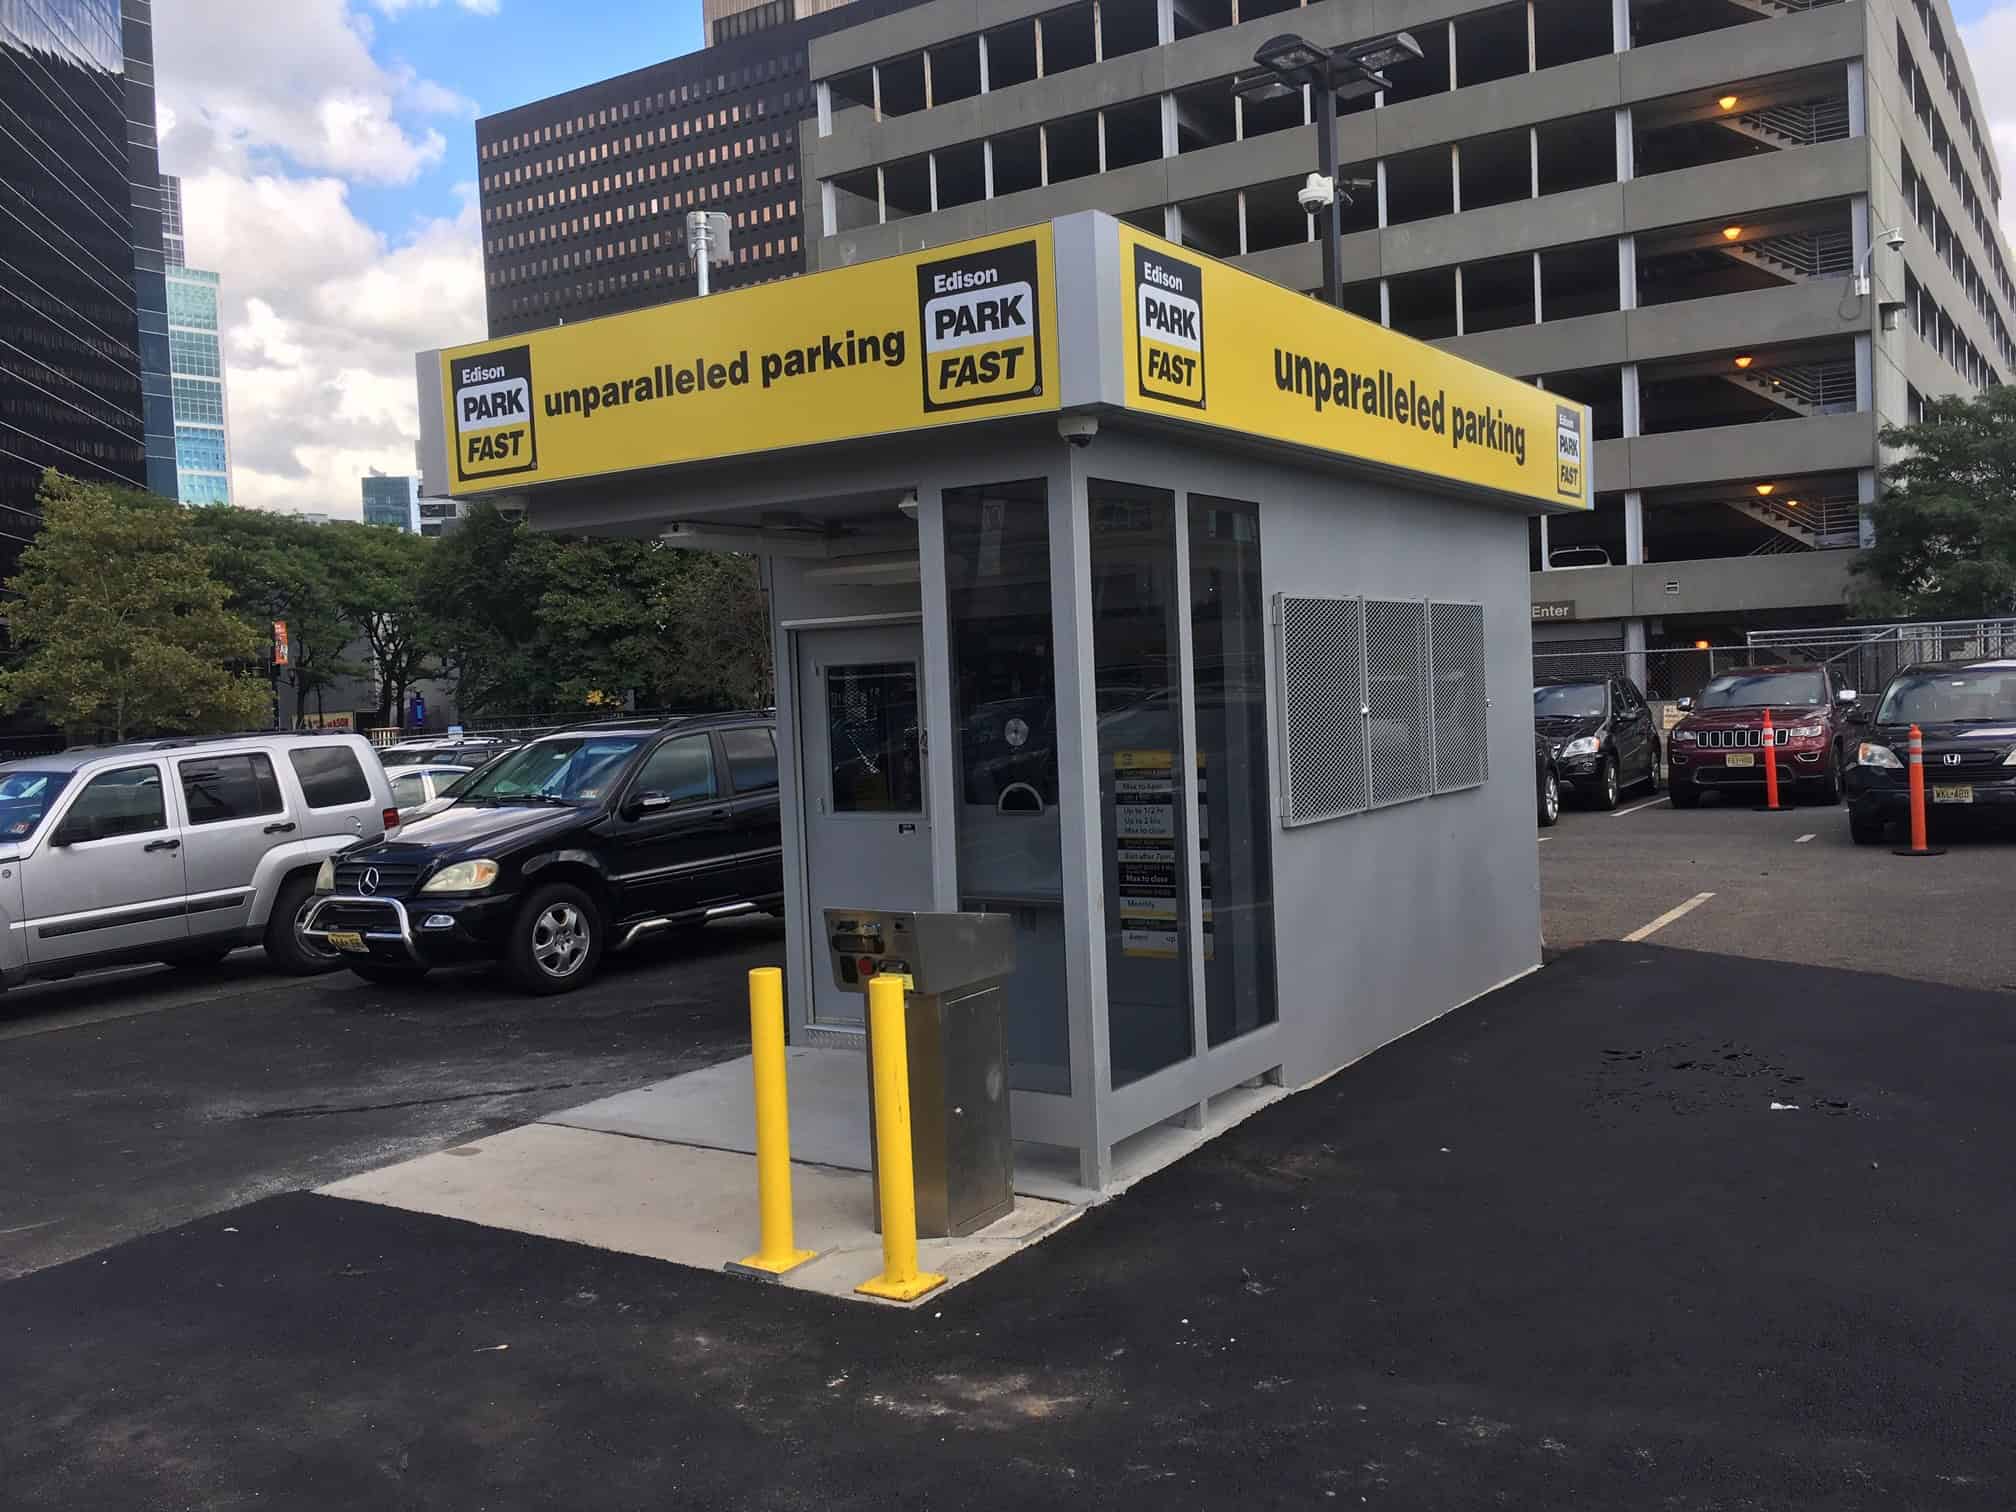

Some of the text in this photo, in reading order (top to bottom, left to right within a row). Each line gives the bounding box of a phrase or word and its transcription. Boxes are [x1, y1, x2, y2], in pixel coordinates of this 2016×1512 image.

[934, 268, 998, 293] Edison
[1144, 262, 1182, 291] Edison
[935, 295, 1026, 340] PARK
[1145, 296, 1196, 340] PARK
[462, 366, 505, 384] Edison
[545, 330, 904, 418] unparalleled parking
[940, 347, 1024, 390] FAST
[1149, 348, 1196, 386] FAST
[464, 388, 525, 421] PARK
[1274, 348, 1526, 466] unparalleled parking
[468, 430, 524, 463] FAST
[1560, 435, 1578, 456] PARK
[1561, 465, 1578, 486] FAST
[1532, 605, 1568, 617] Enter
